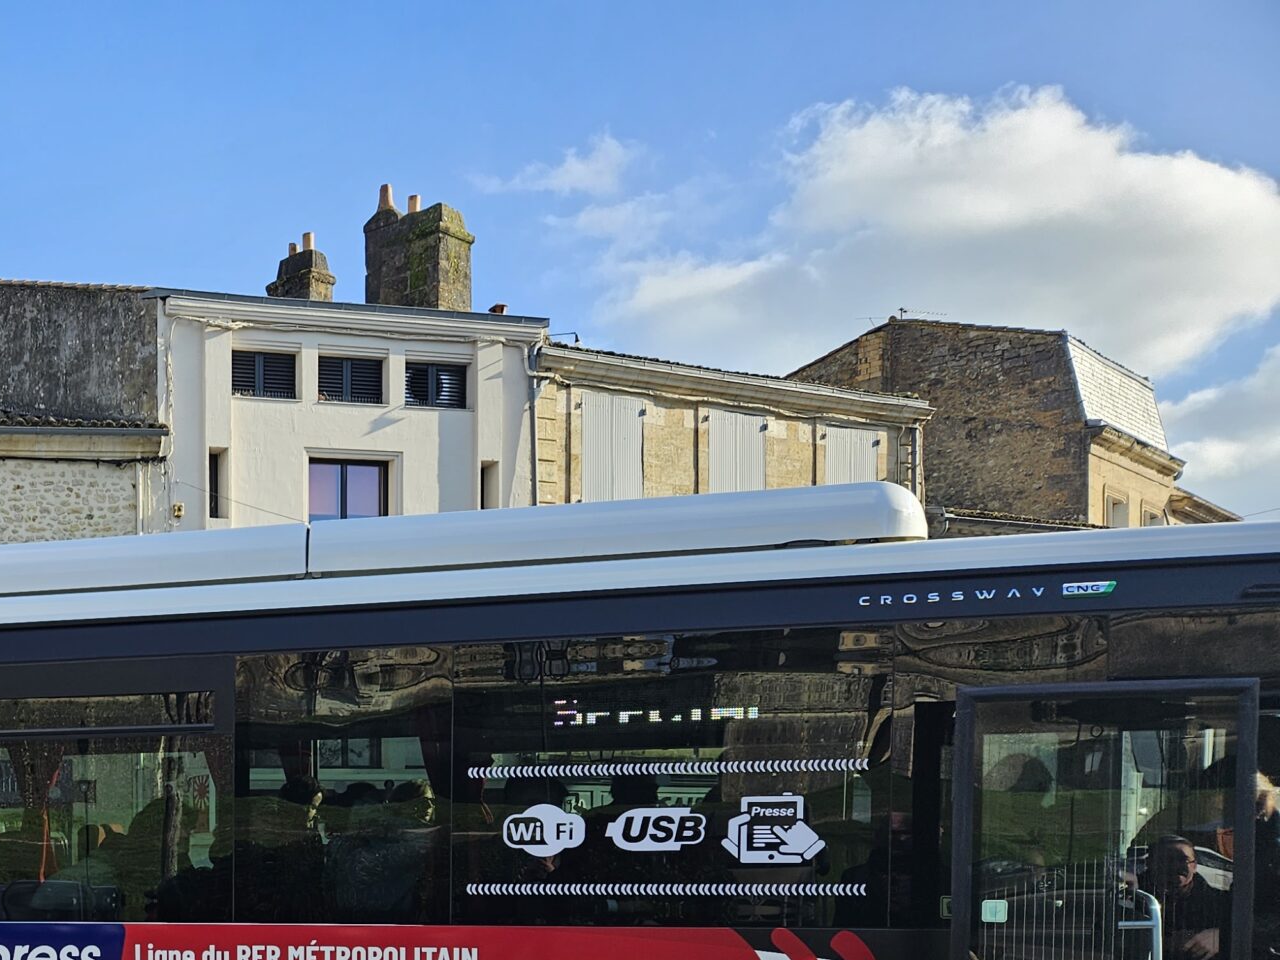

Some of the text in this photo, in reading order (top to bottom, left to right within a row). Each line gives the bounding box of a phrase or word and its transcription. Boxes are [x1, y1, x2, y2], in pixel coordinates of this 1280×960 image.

[858, 586, 1045, 606] CROSSWAY
[751, 806, 795, 818] Presse
[621, 815, 705, 843] USB
